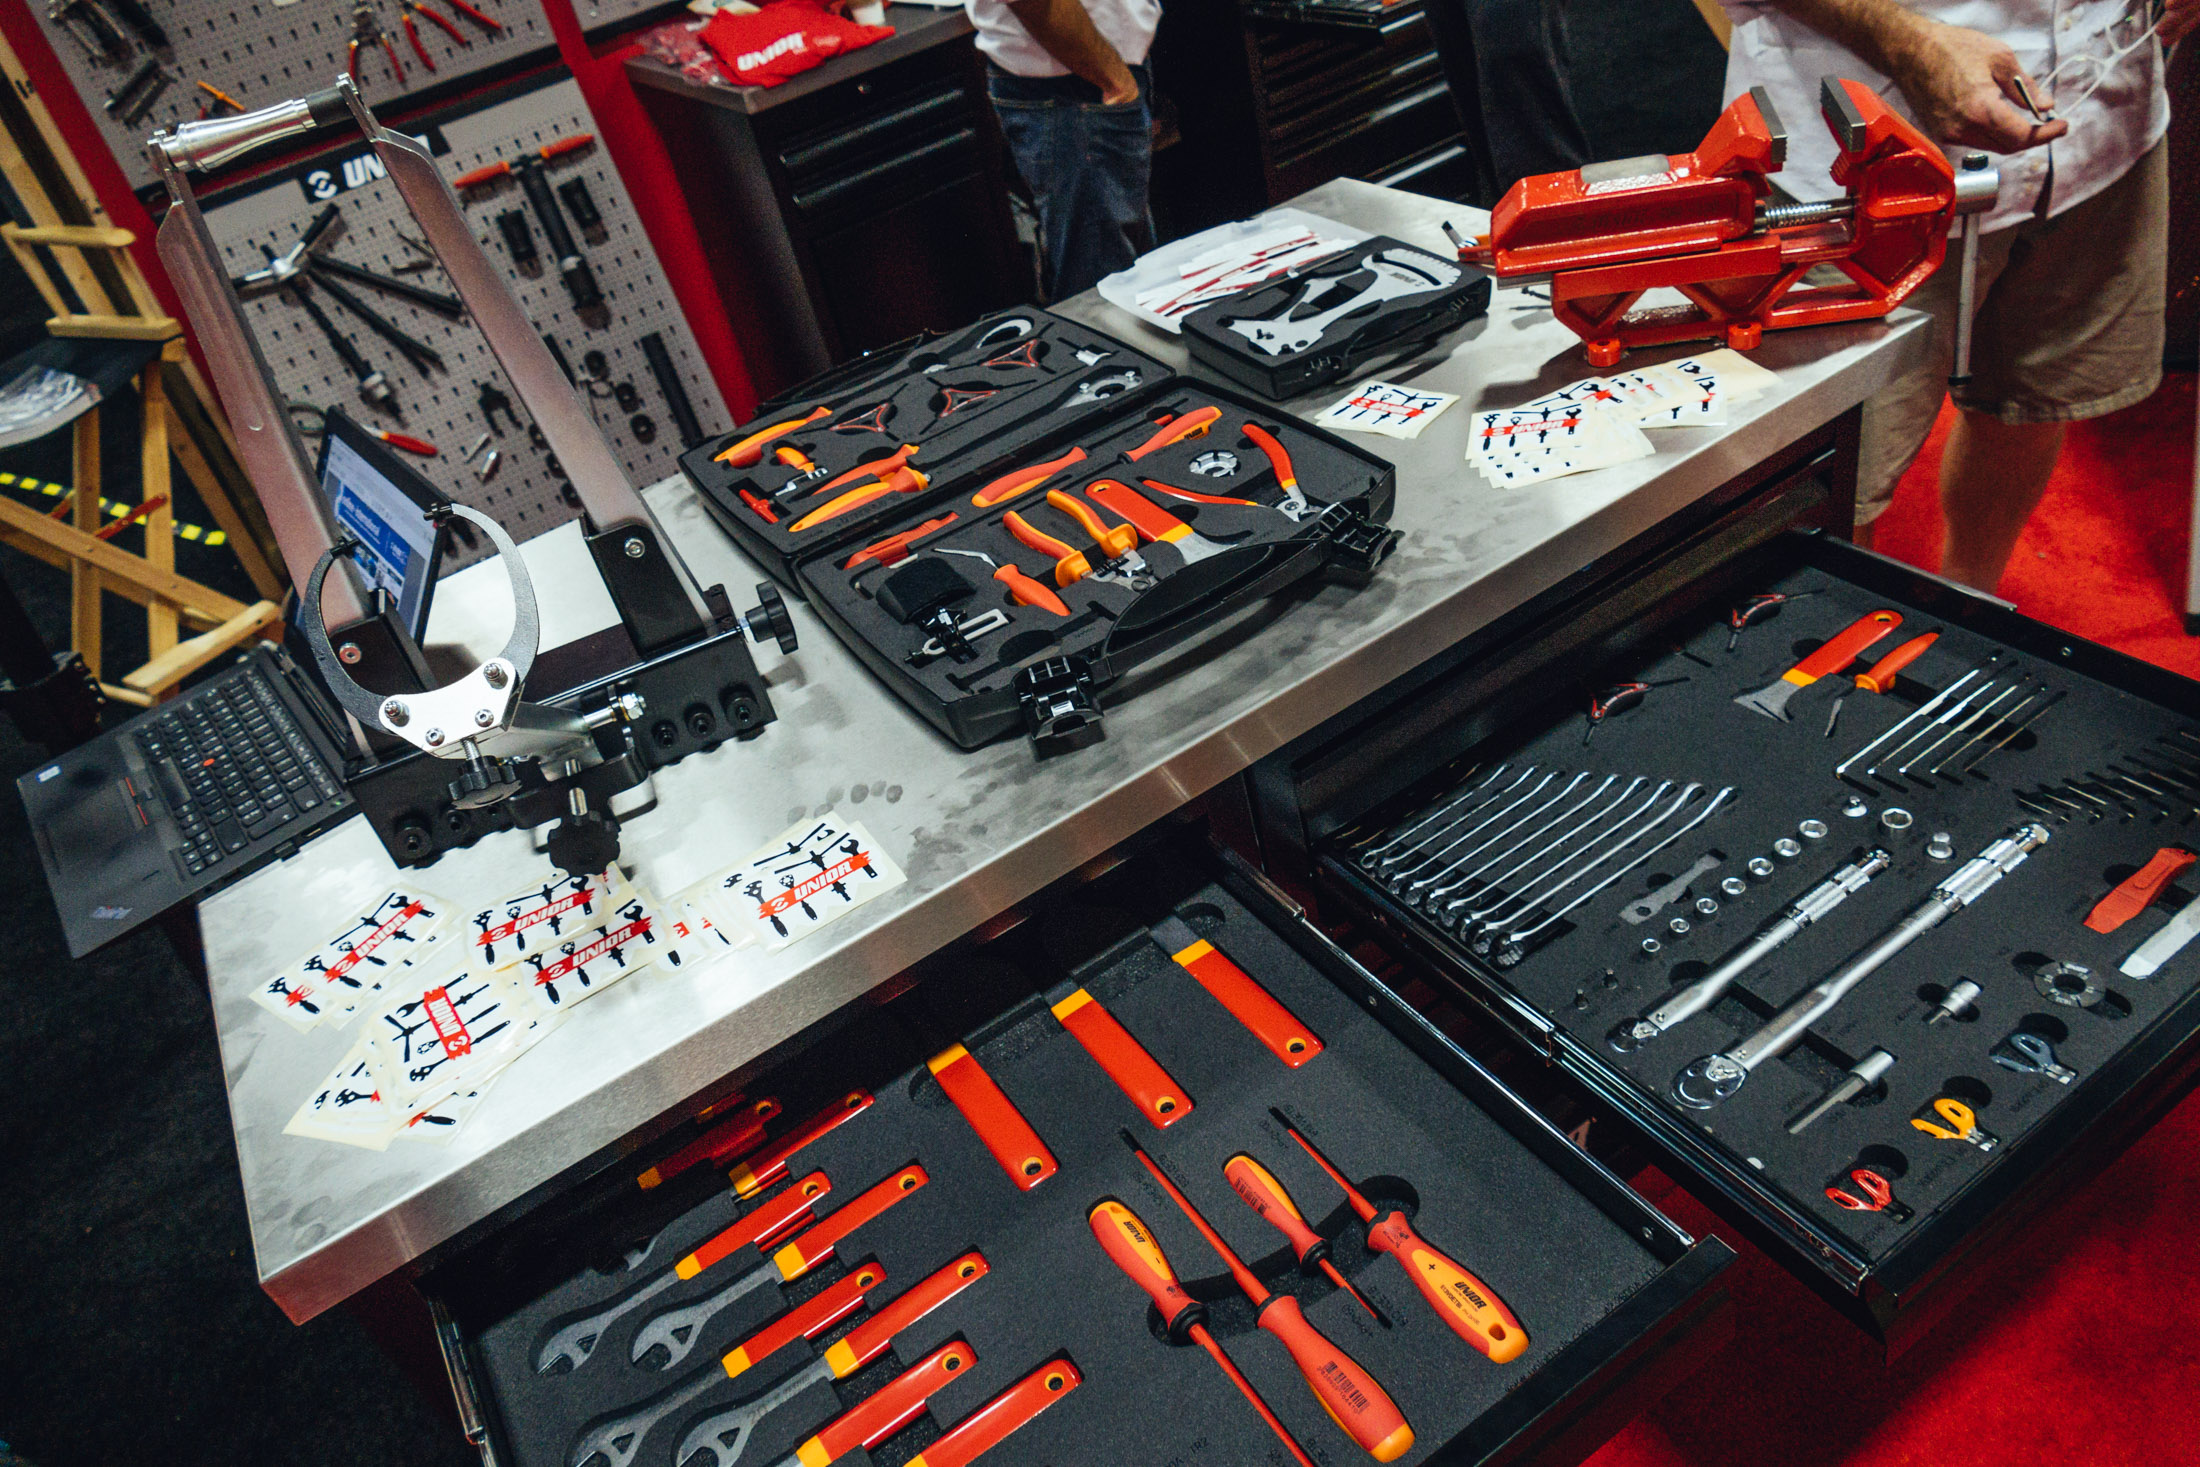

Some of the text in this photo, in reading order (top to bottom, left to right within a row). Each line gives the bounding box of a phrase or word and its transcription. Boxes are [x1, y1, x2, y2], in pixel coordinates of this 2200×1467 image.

[737, 32, 805, 71] UNIOR
[1512, 420, 1563, 435] UNIOR
[793, 860, 853, 900] UNIOR
[514, 897, 574, 932] UNIOR
[354, 914, 409, 958] UNIOR
[573, 926, 633, 968] UNIOR
[428, 997, 462, 1038] UNIOR
[1123, 1221, 1146, 1243] UNIOR
[1454, 1281, 1488, 1309] UNIOR
